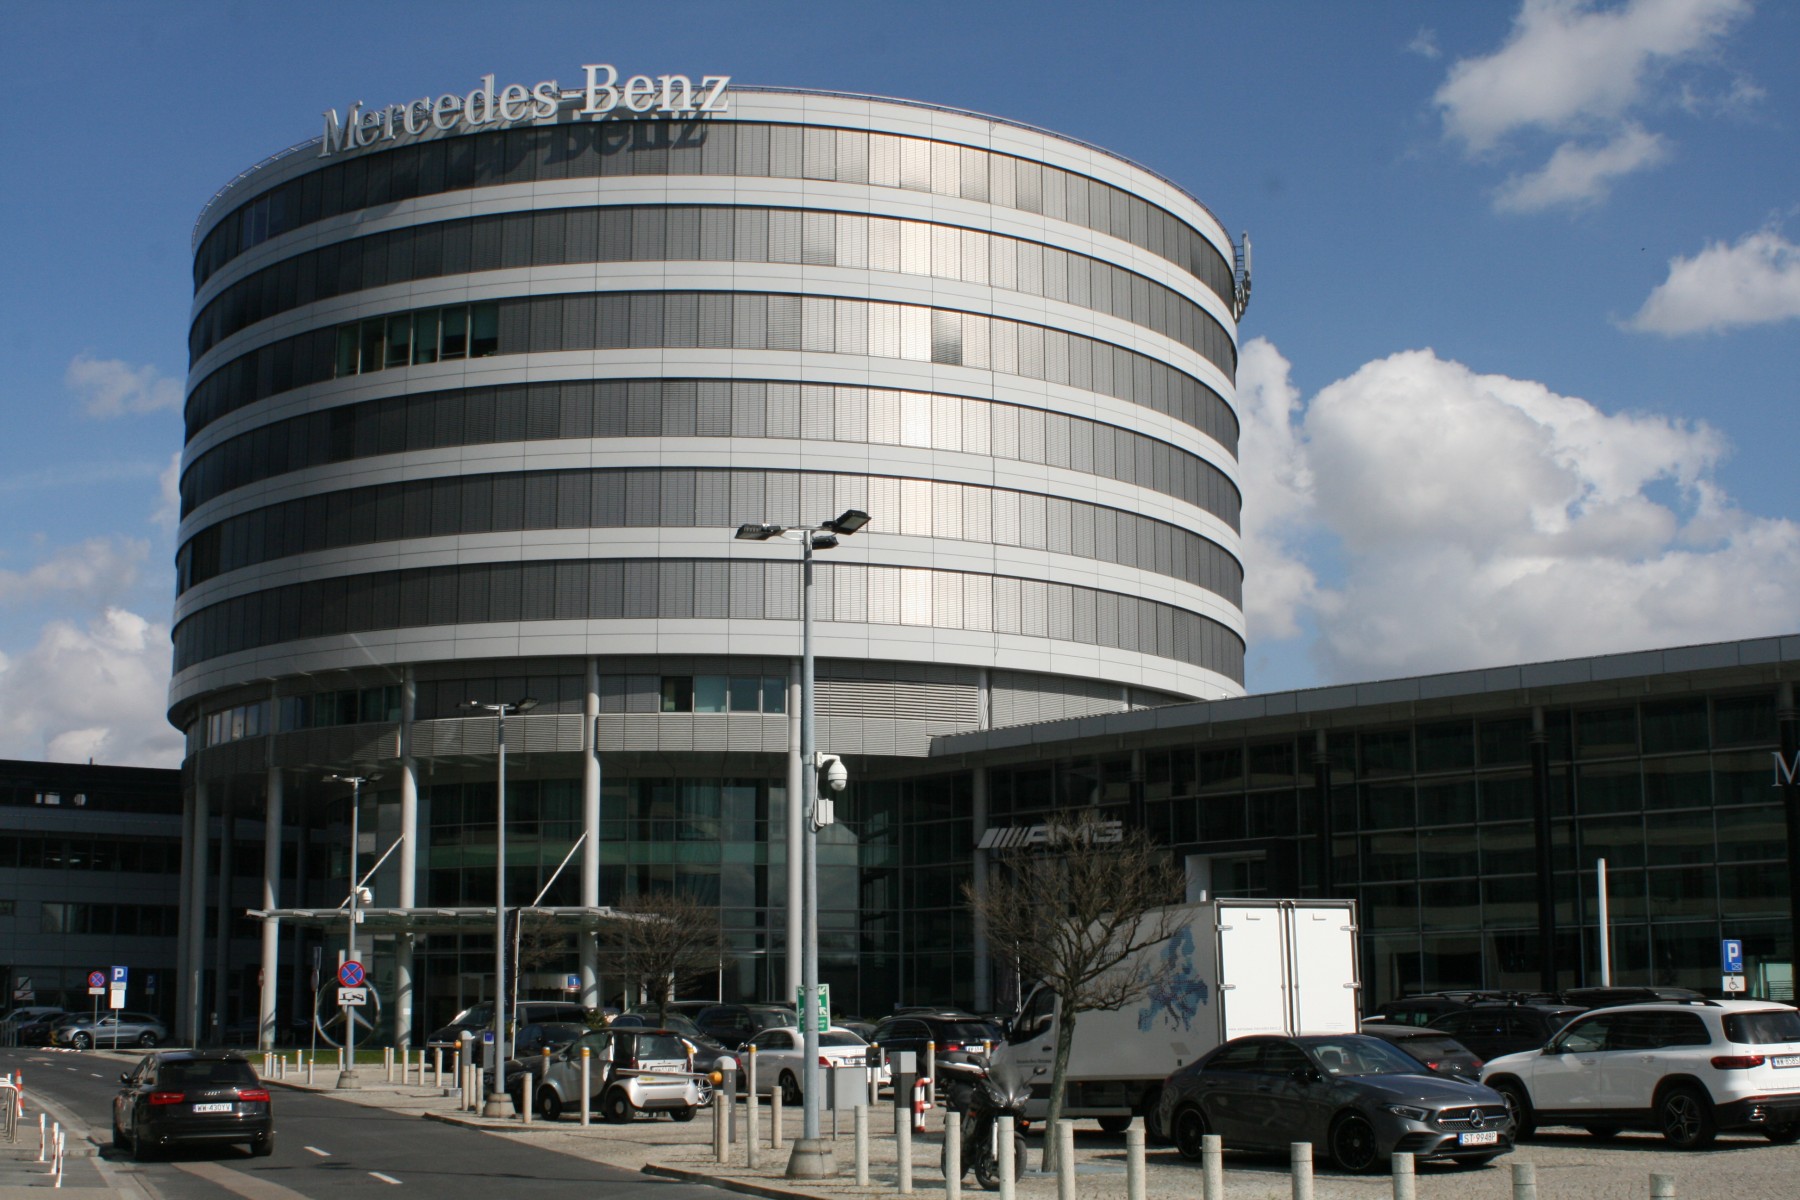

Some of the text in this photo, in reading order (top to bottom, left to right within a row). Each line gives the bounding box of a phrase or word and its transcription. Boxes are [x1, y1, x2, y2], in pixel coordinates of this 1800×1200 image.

[318, 63, 732, 159] Mercedes-Benz
[1022, 820, 1123, 847] AMG
[1728, 943, 1738, 963] P
[114, 968, 125, 981] P
[1463, 1133, 1474, 1144] ST
